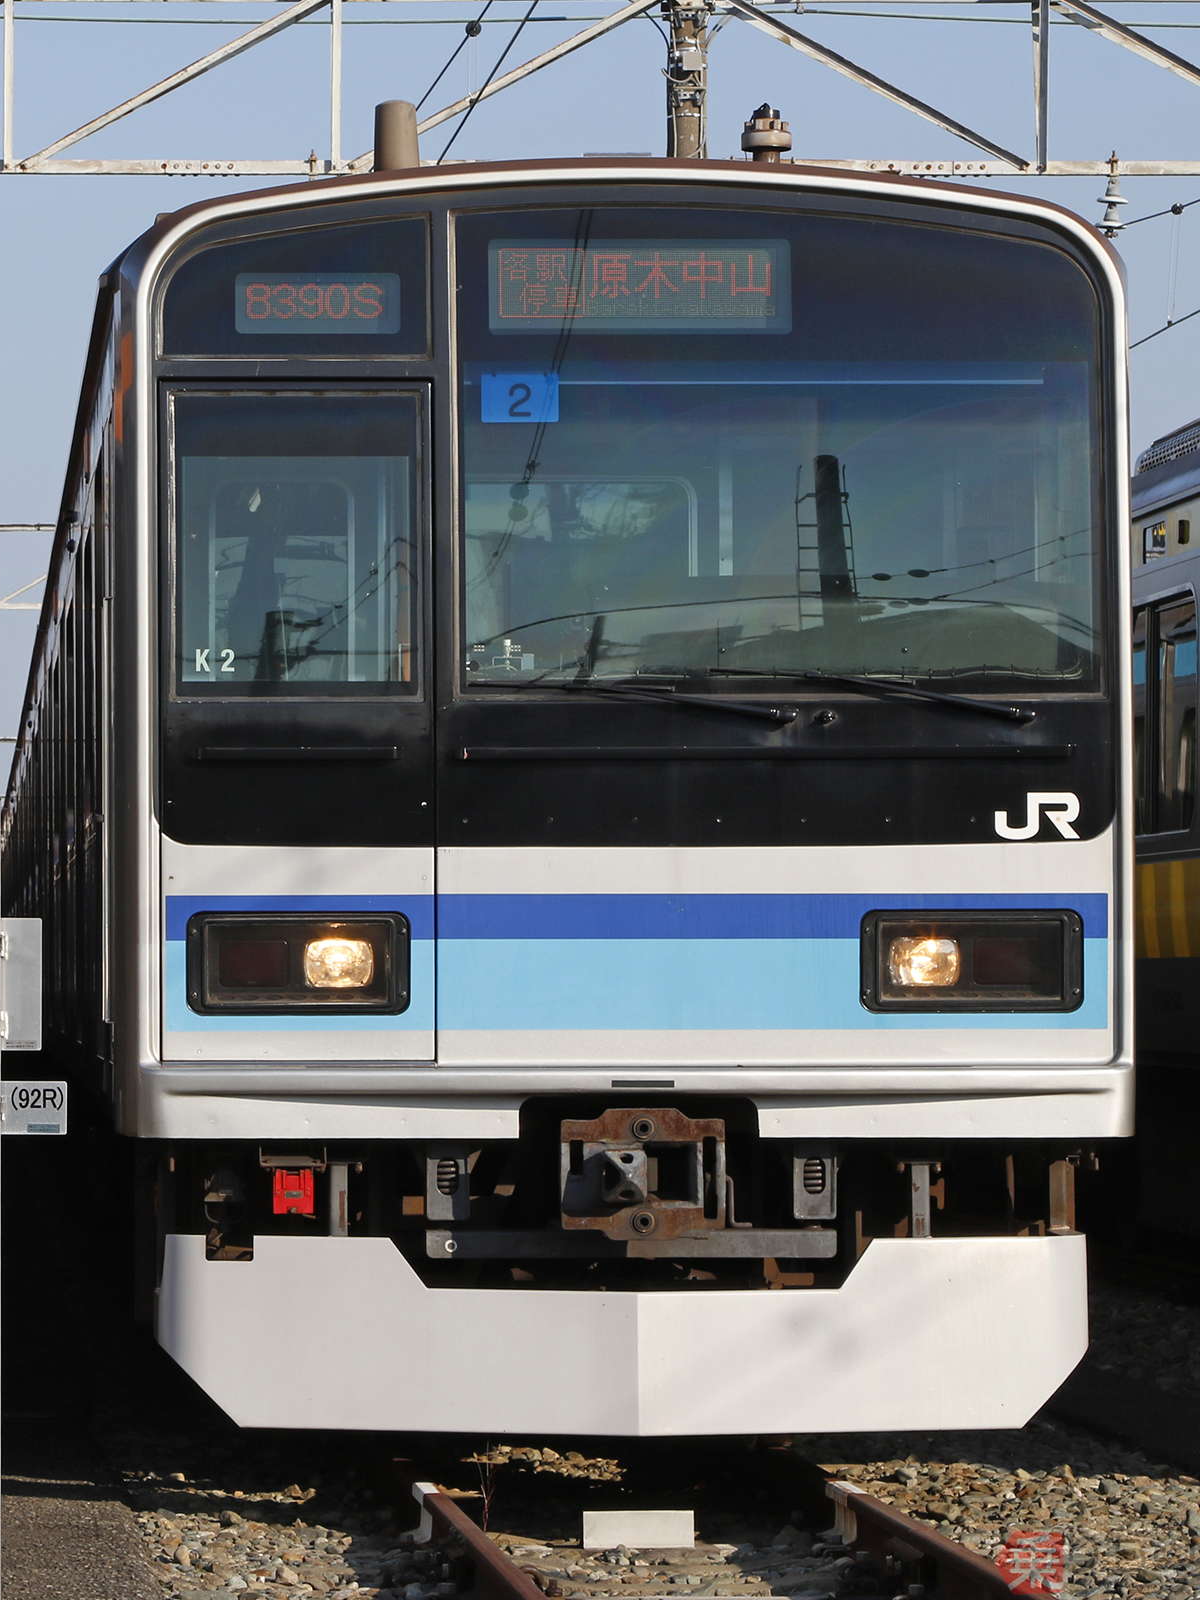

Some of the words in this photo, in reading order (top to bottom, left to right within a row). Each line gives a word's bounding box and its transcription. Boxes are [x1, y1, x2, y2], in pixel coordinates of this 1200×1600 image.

[503, 254, 568, 281] 各駅
[588, 251, 772, 299] 原木中山
[245, 282, 385, 320] 8390S
[519, 282, 582, 314] 停車
[508, 382, 532, 417] 2
[994, 791, 1081, 841] JR
[11, 1086, 64, 1111] (92R)
